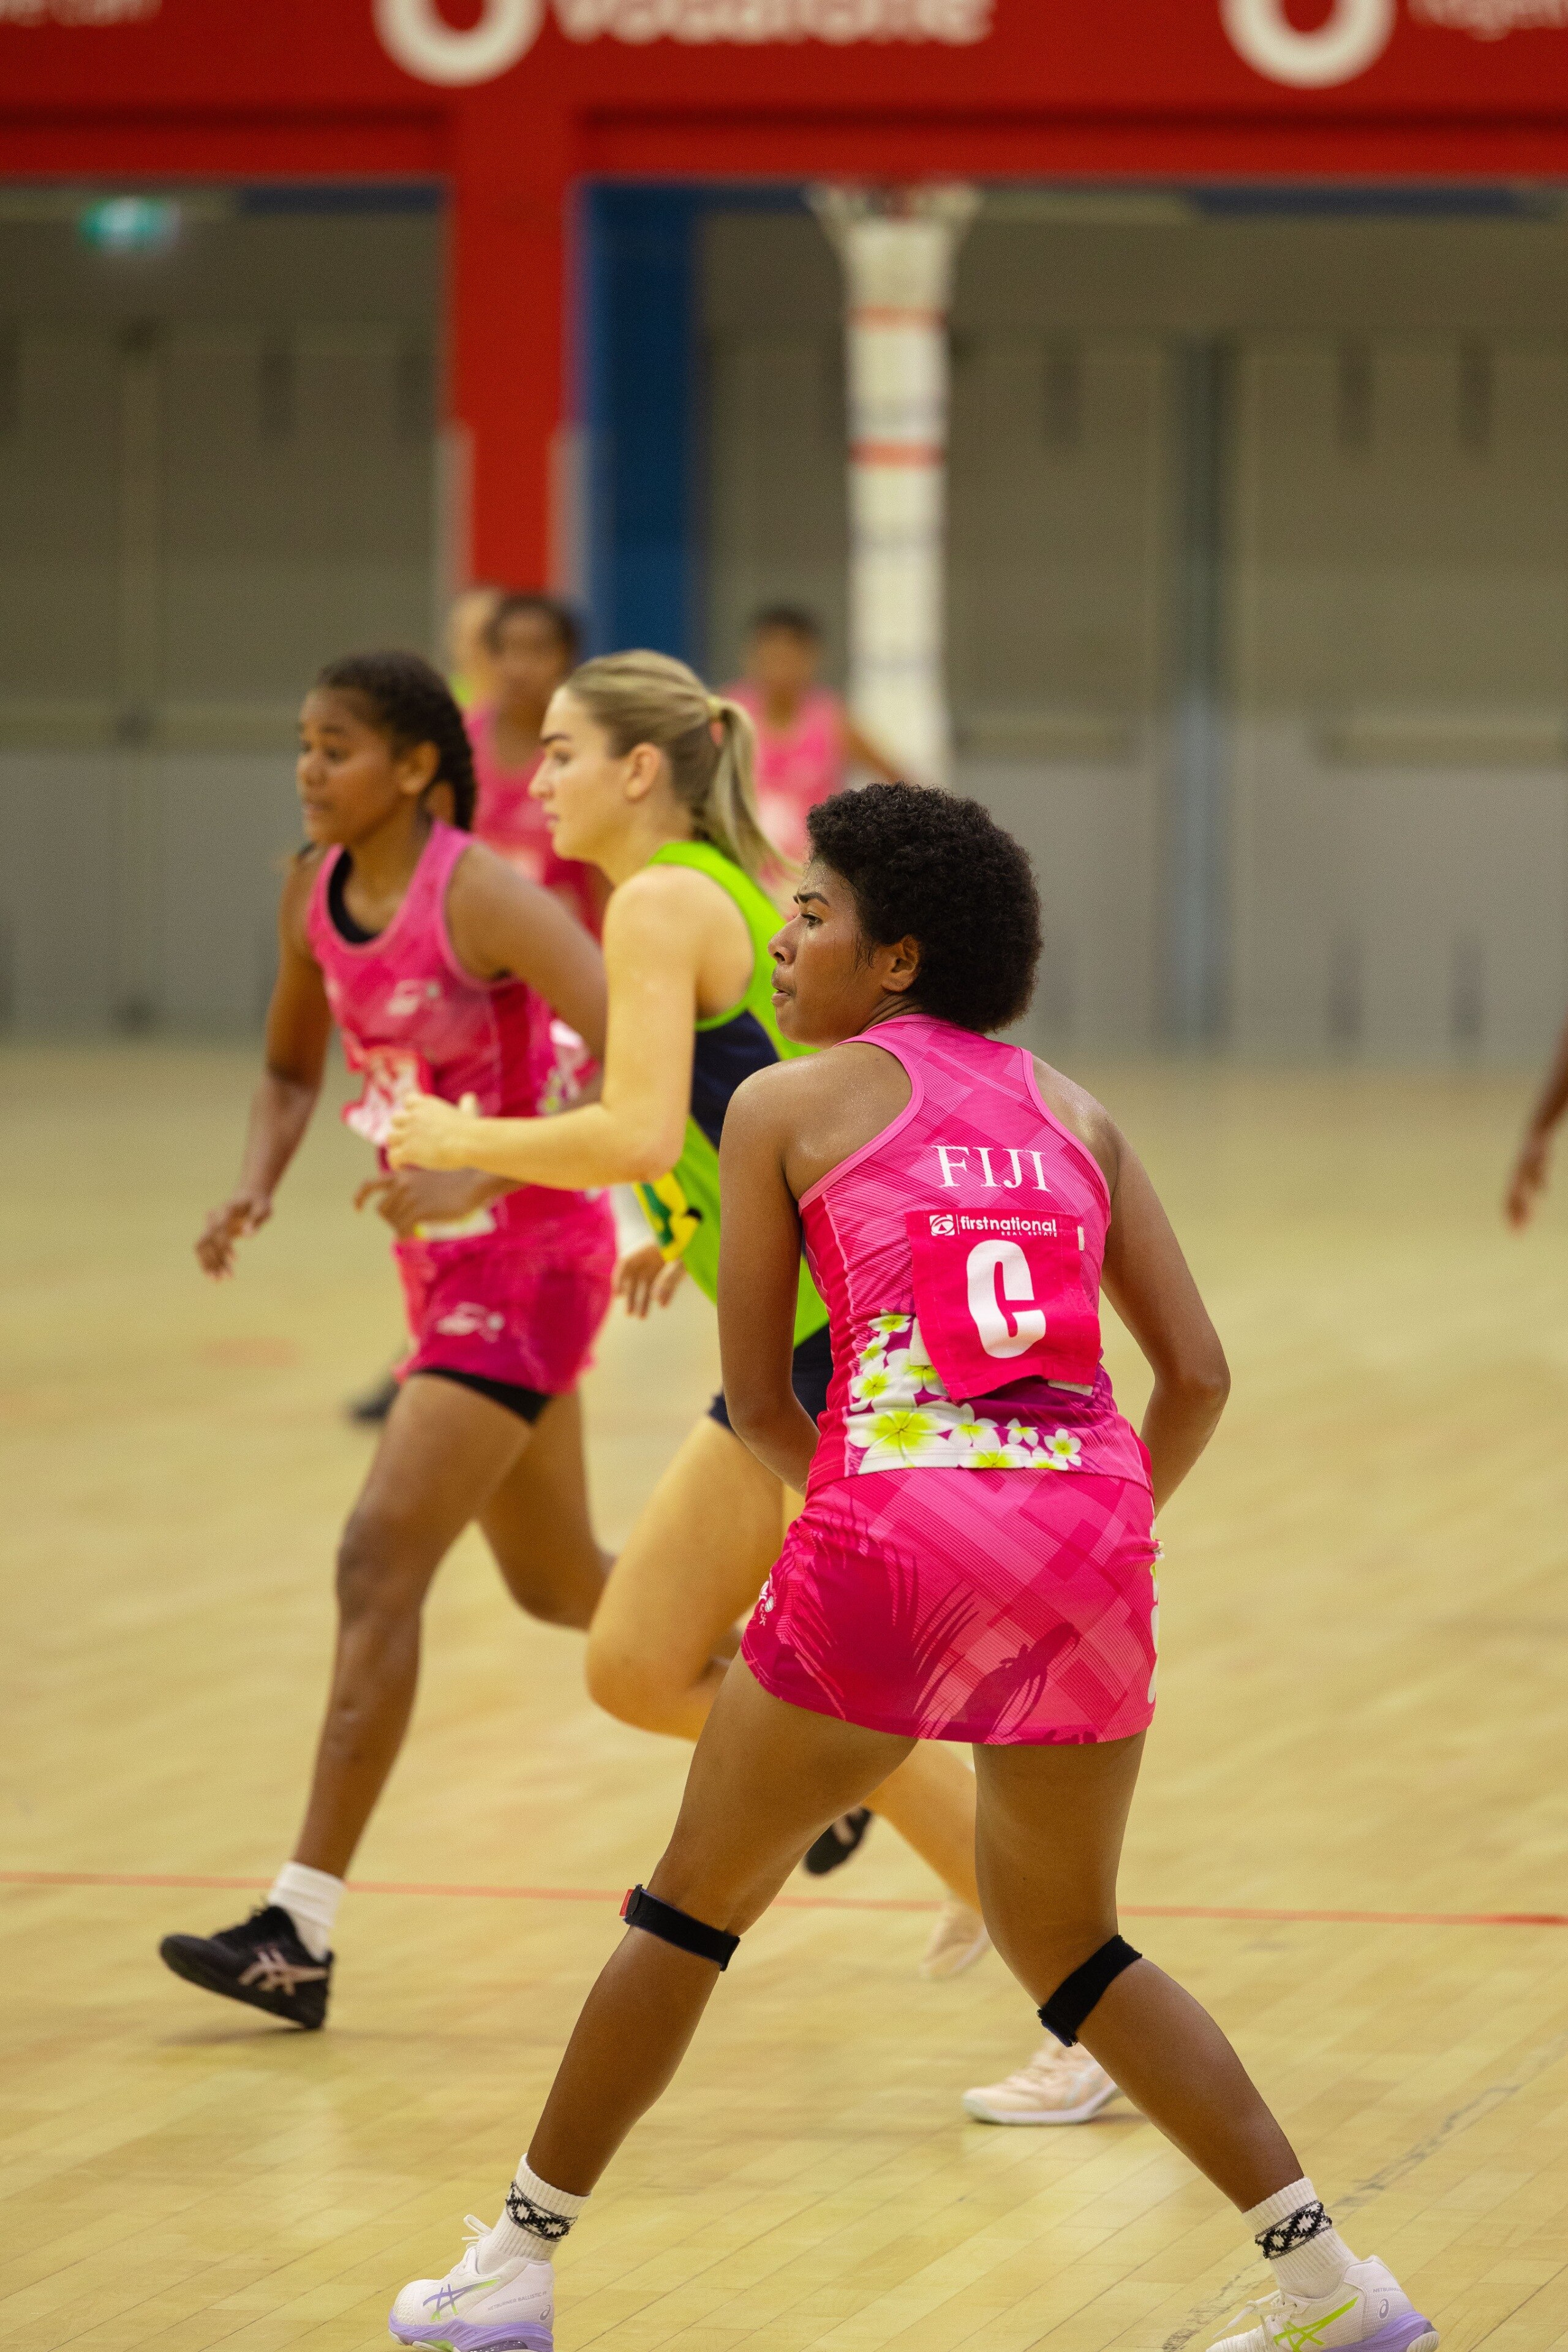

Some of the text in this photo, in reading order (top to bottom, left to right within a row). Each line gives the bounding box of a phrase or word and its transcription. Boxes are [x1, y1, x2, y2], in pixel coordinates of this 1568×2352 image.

[932, 1145, 1052, 1193] FIJI
[967, 1239, 1047, 1359] C
[518, 2291, 542, 2301] BALLISTIC
